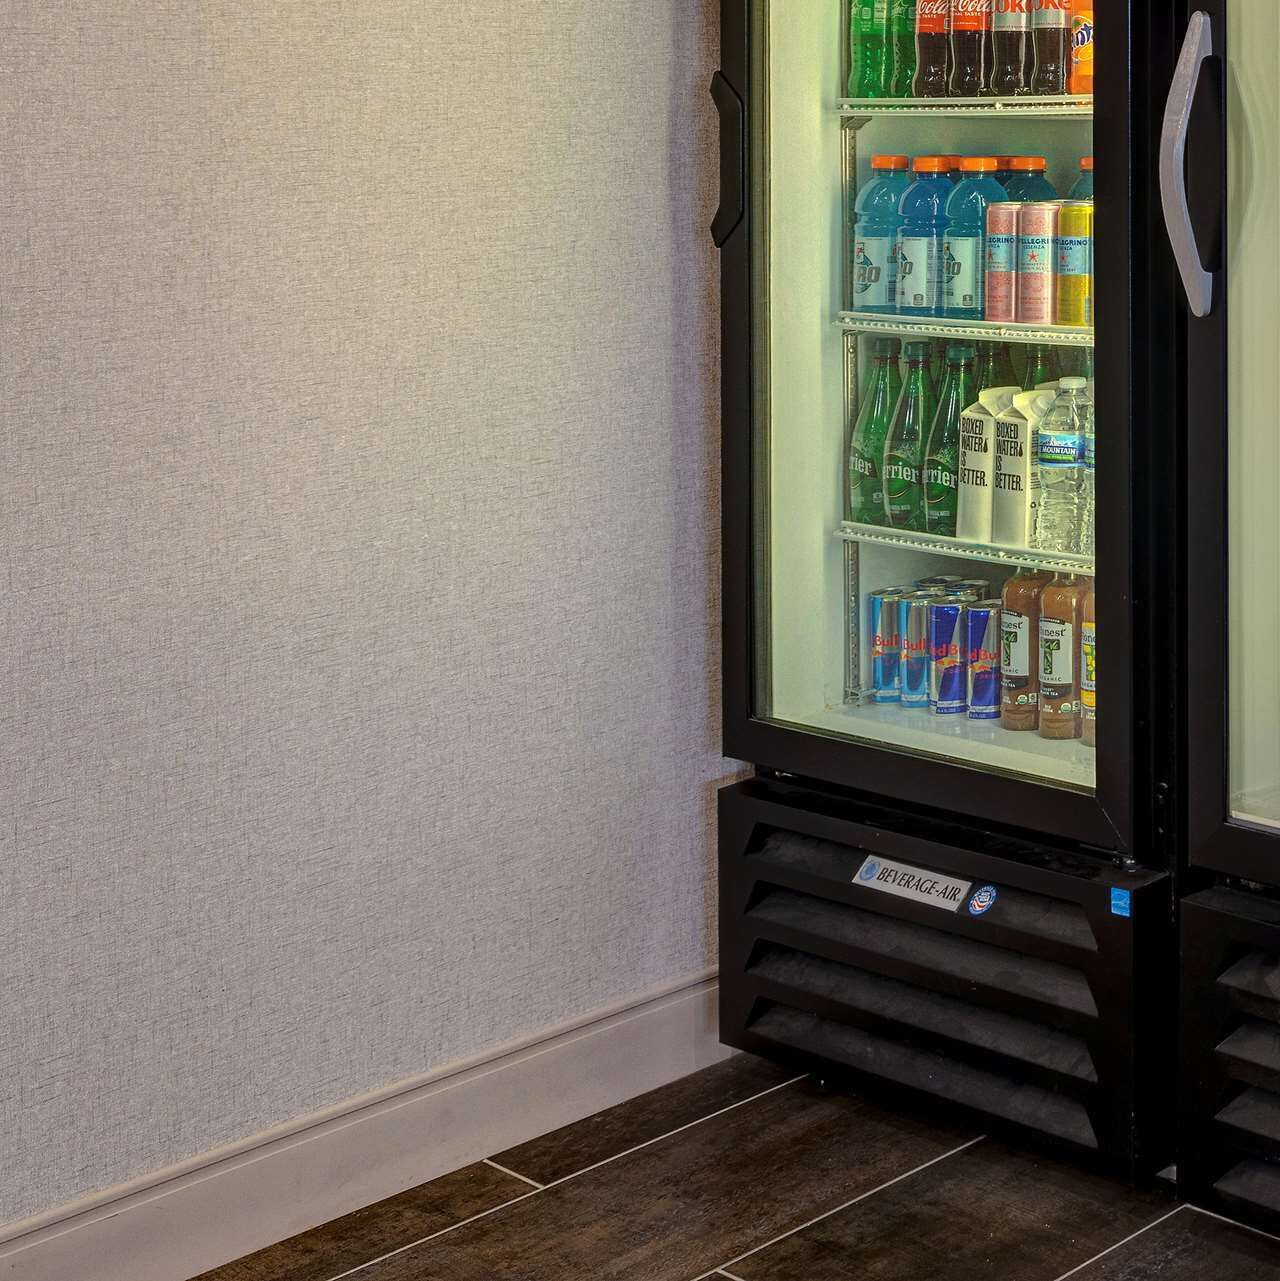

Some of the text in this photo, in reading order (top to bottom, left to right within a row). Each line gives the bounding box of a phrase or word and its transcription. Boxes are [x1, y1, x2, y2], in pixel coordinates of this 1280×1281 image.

[961, 419, 984, 435] BOXED
[996, 423, 1019, 439] BOXED
[961, 437, 983, 452] WATER
[996, 441, 1018, 456] WATER
[876, 867, 961, 902] BEVERAGE-AIR
